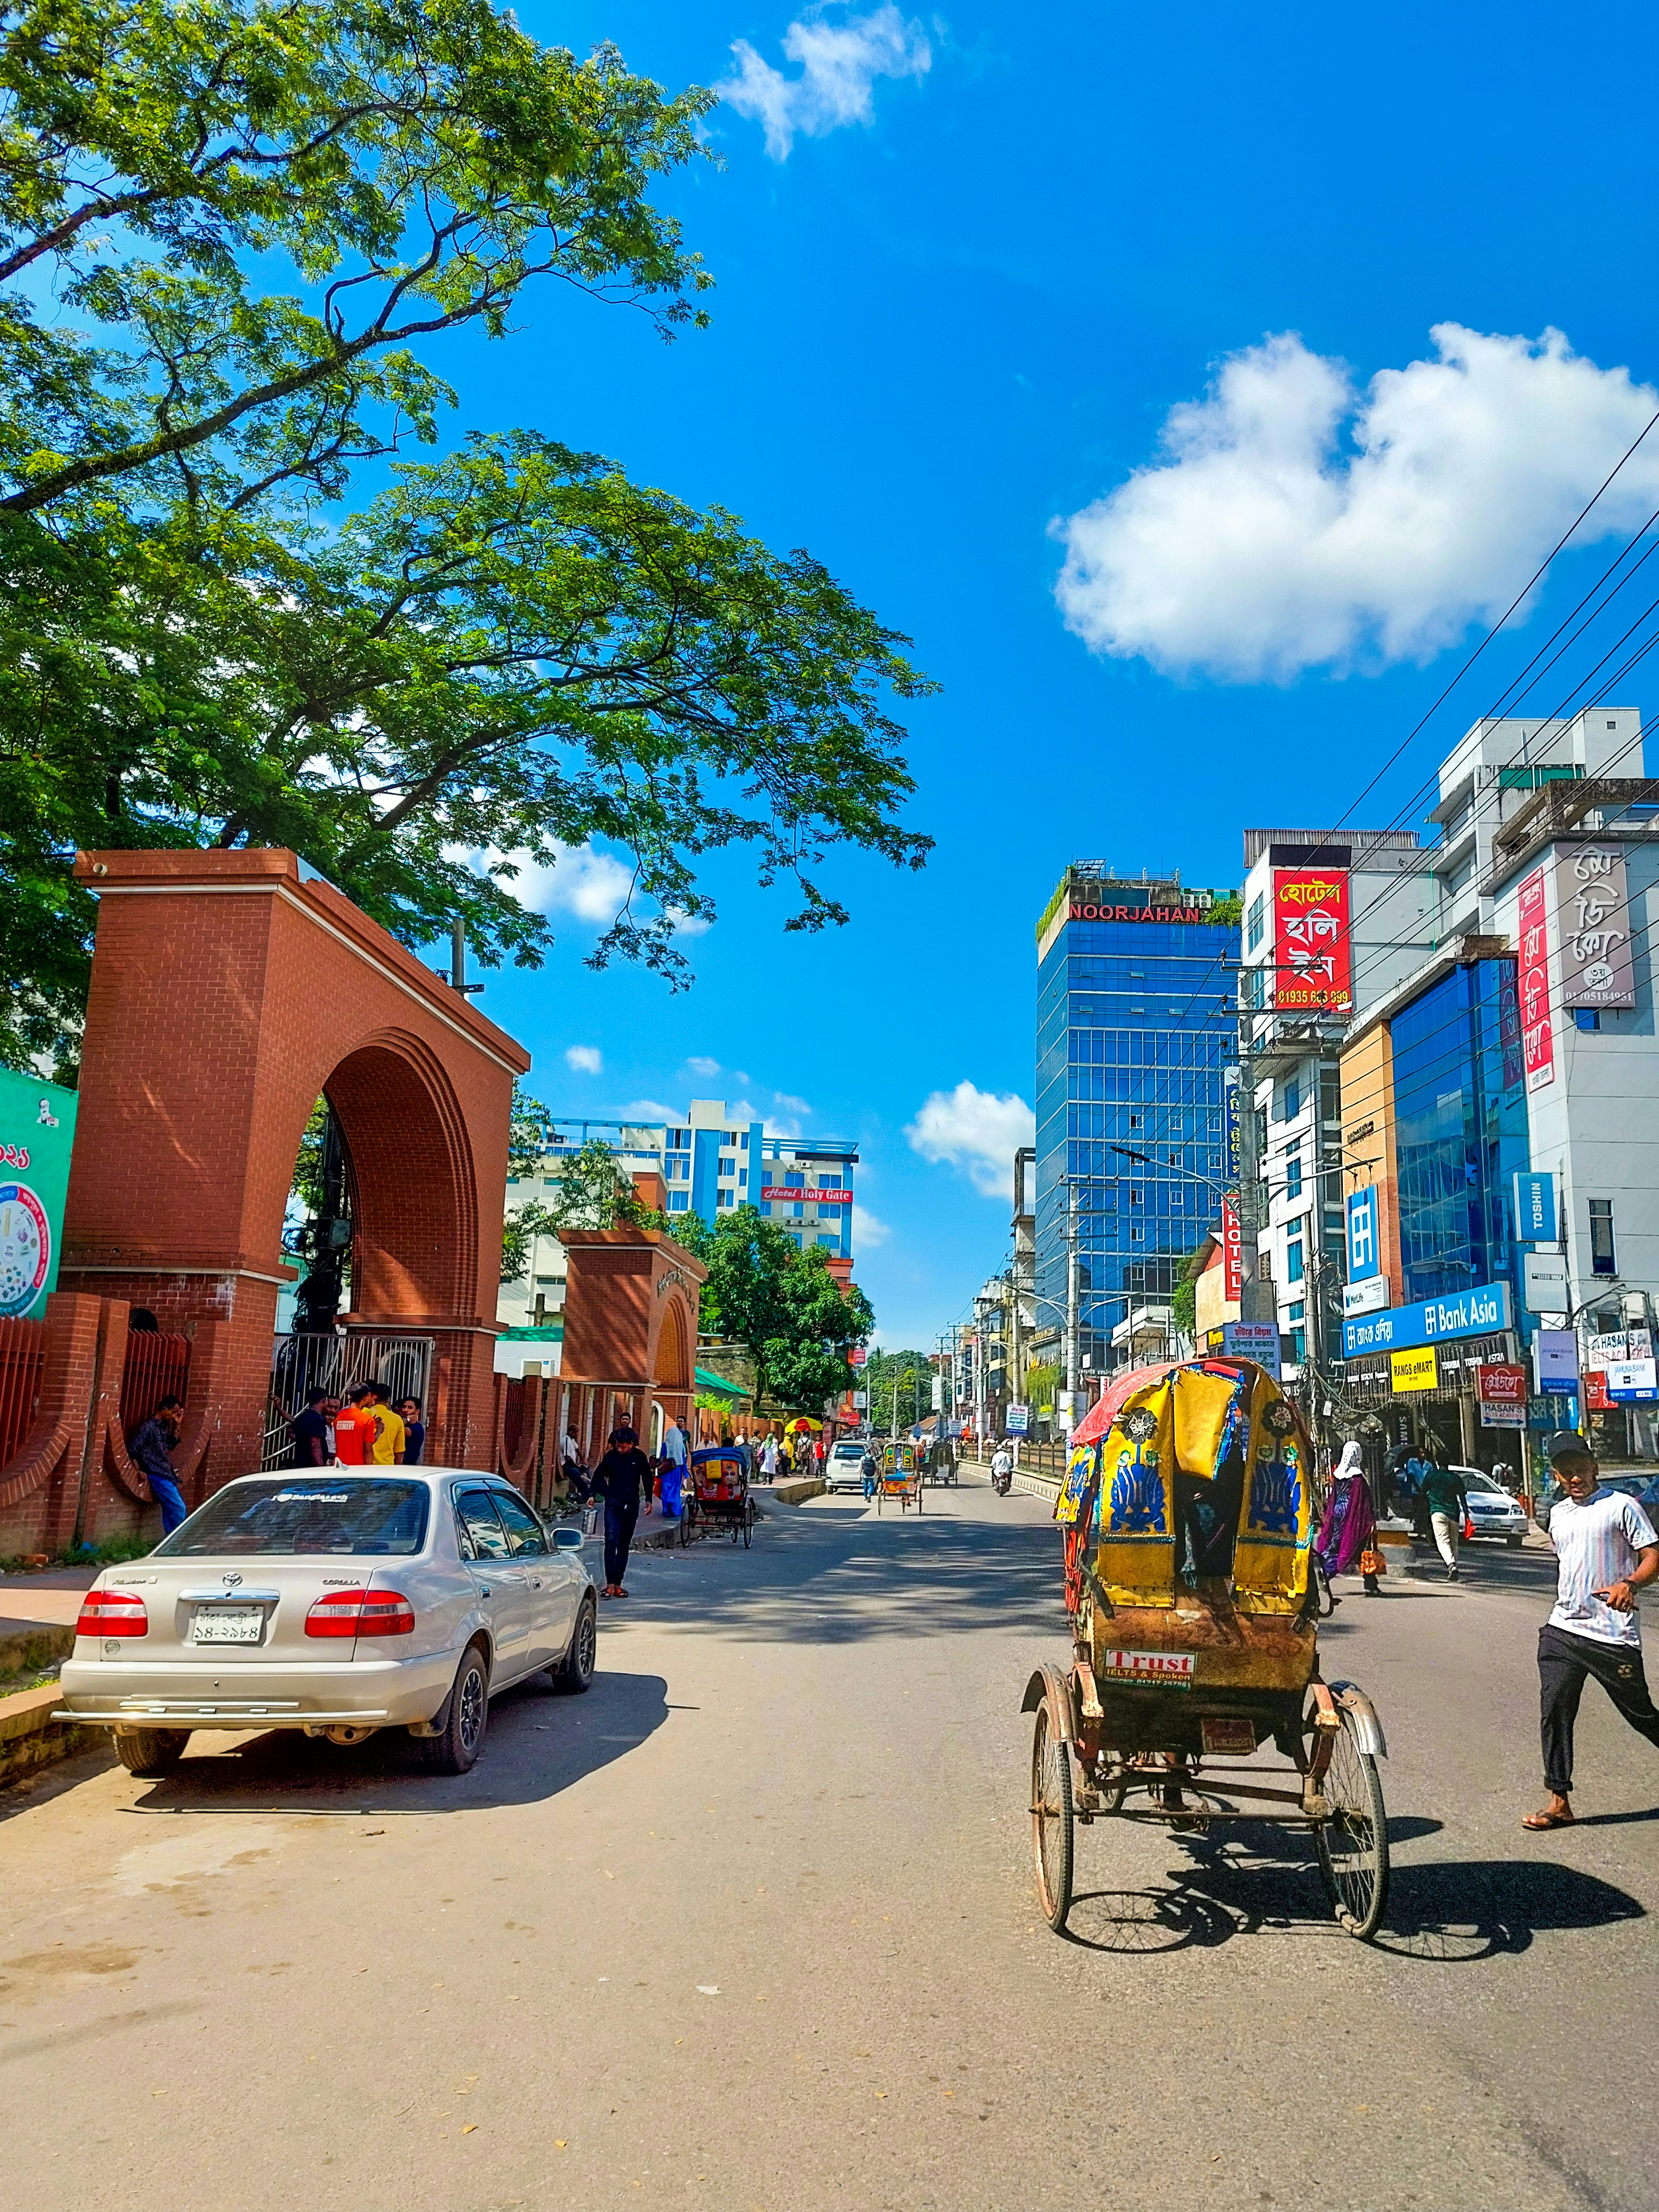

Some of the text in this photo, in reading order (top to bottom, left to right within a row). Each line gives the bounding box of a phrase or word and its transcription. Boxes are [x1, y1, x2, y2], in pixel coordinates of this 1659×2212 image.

[1279, 878, 1342, 907] হোটেল
[1069, 904, 1199, 923] NOORJAHAN
[1281, 908, 1341, 947] হলি
[1278, 989, 1308, 1004] 01935
[1330, 990, 1349, 1004] 999
[764, 1188, 849, 1201] Hotel Holy Gate
[1531, 1183, 1543, 1230] TOSHIN
[1438, 1294, 1497, 1332] Bank Asia
[1394, 1360, 1433, 1377] RANGS eMART
[1484, 1404, 1522, 1414] HASAN'S
[1109, 1650, 1192, 1671] Trust
[1107, 1669, 1137, 1677] IELTS
[1152, 1671, 1190, 1680] Spoken
